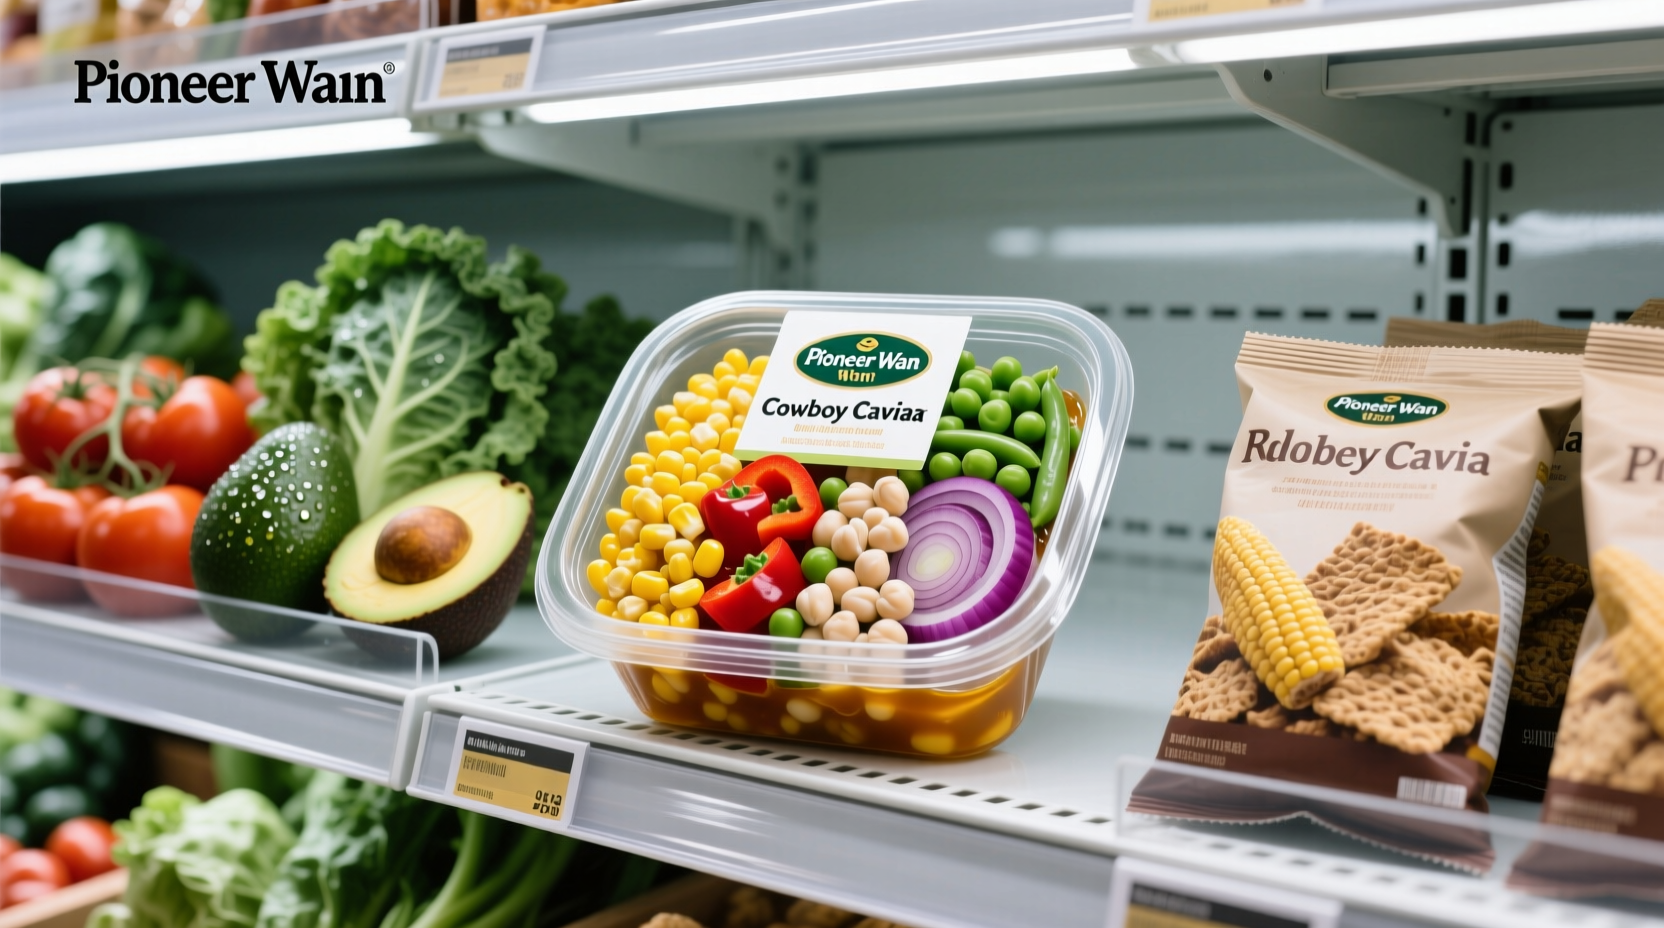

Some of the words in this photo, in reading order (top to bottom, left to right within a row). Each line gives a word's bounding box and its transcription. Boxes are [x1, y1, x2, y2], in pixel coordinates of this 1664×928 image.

[804, 347, 877, 368] Pioneer
[878, 351, 921, 370] Wan
[761, 397, 849, 424] Cowboy
[1333, 396, 1398, 413] Pioneer
[1399, 402, 1439, 415] Wan
[1241, 428, 1382, 476] Rdobey
[1384, 440, 1491, 477] Cavia
